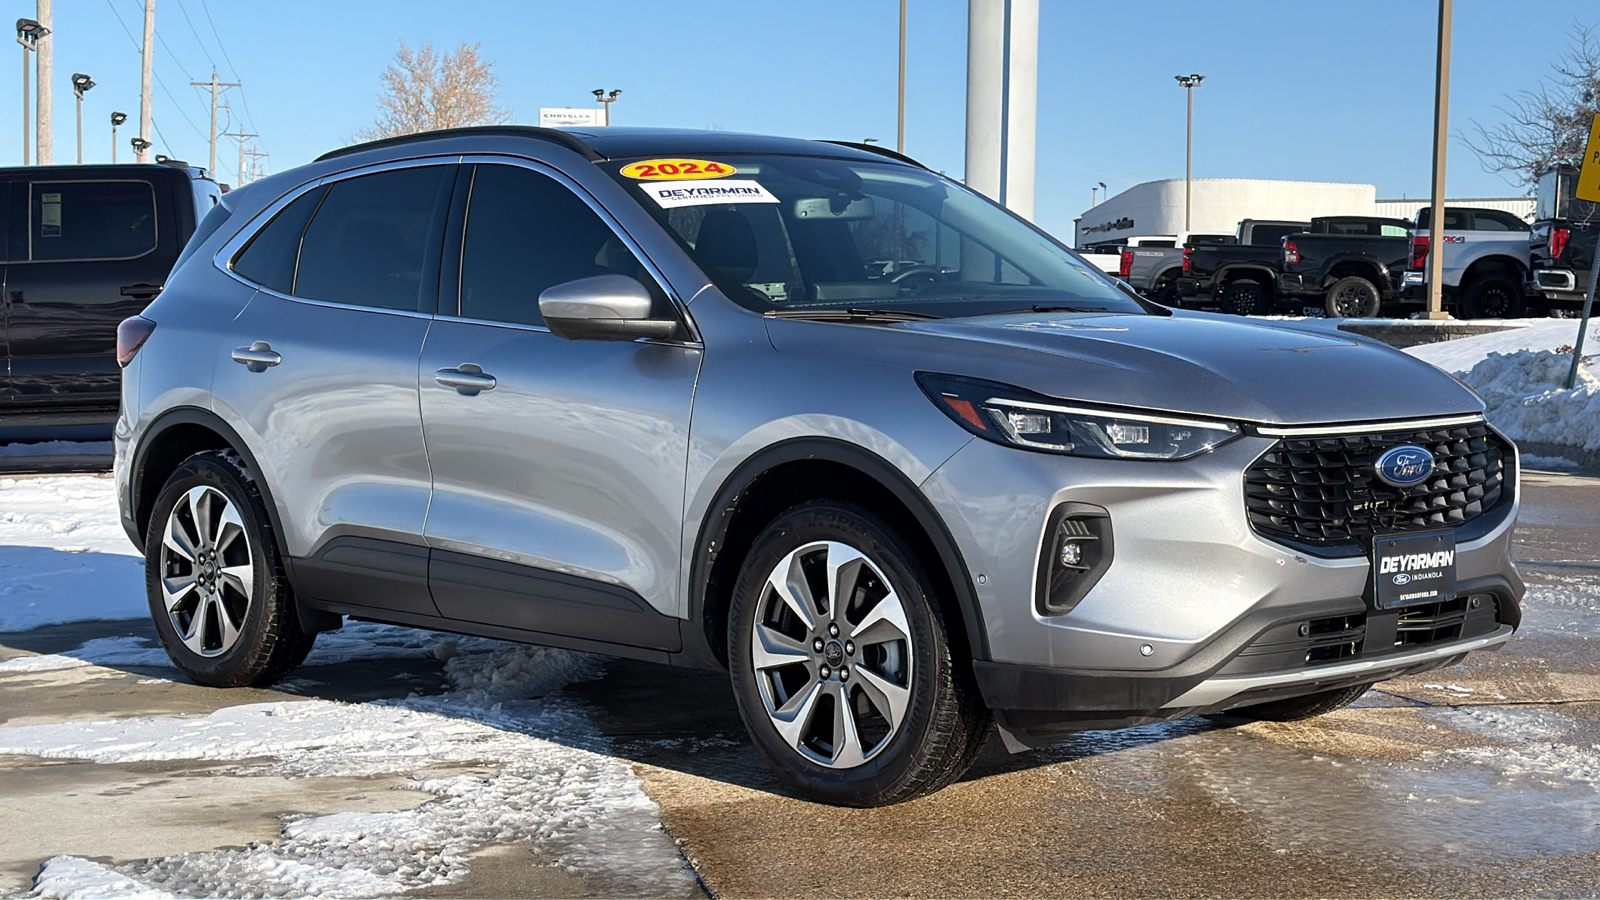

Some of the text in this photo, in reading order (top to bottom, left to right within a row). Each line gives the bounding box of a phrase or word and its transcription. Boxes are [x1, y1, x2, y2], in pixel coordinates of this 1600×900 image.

[634, 162, 726, 177] 2024
[658, 187, 761, 198] DEYARMAN
[1443, 235, 1466, 244] X4
[1393, 454, 1426, 477] Ford
[1380, 550, 1454, 574] DEYARMAN
[1411, 571, 1443, 581] INDIANOLA
